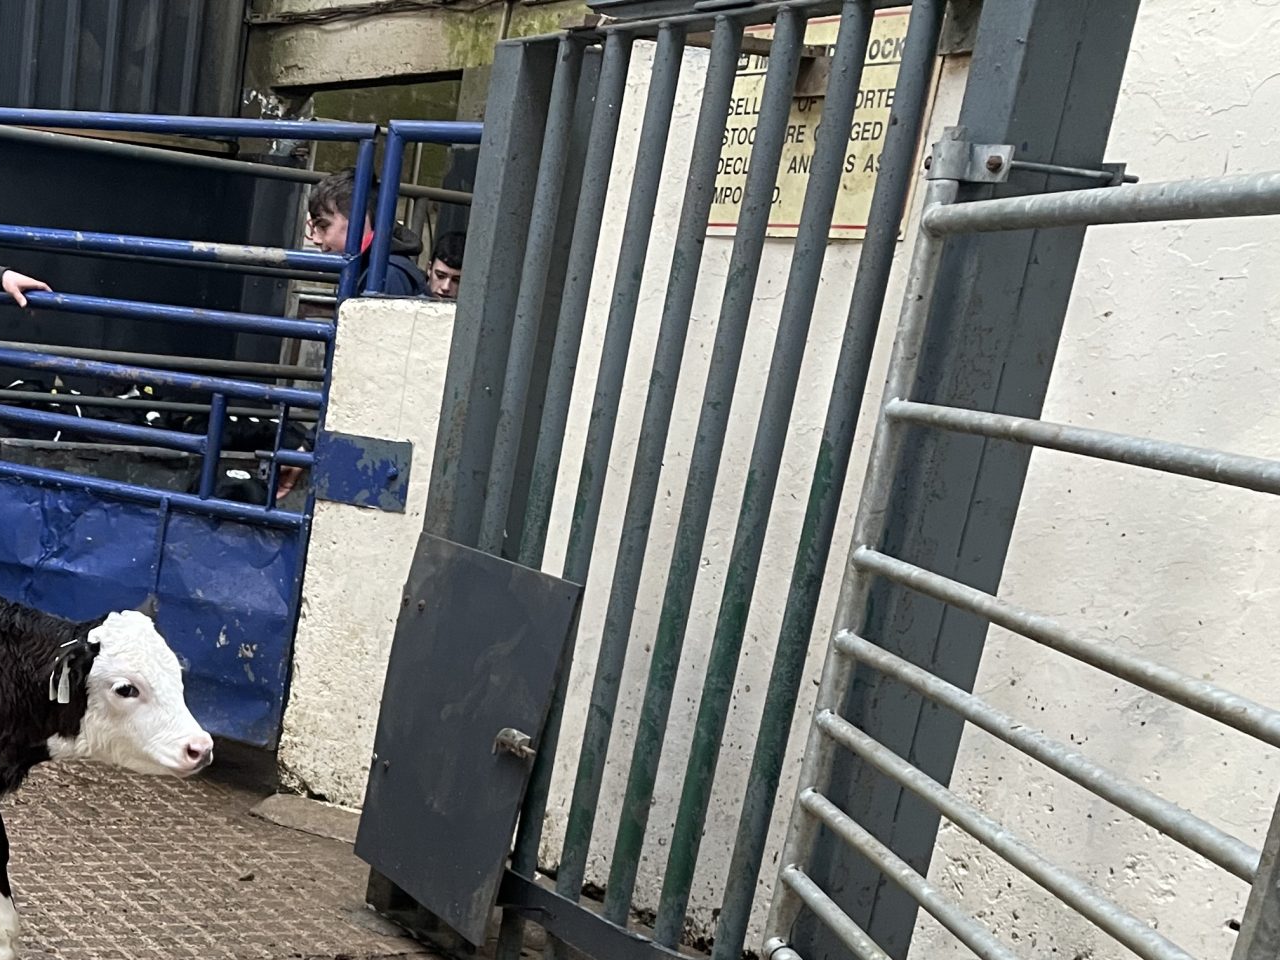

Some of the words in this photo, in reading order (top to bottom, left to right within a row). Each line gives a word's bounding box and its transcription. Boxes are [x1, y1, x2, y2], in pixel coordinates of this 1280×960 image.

[868, 37, 906, 61] OCK
[721, 126, 757, 146] STOC
[785, 124, 807, 144] RE
